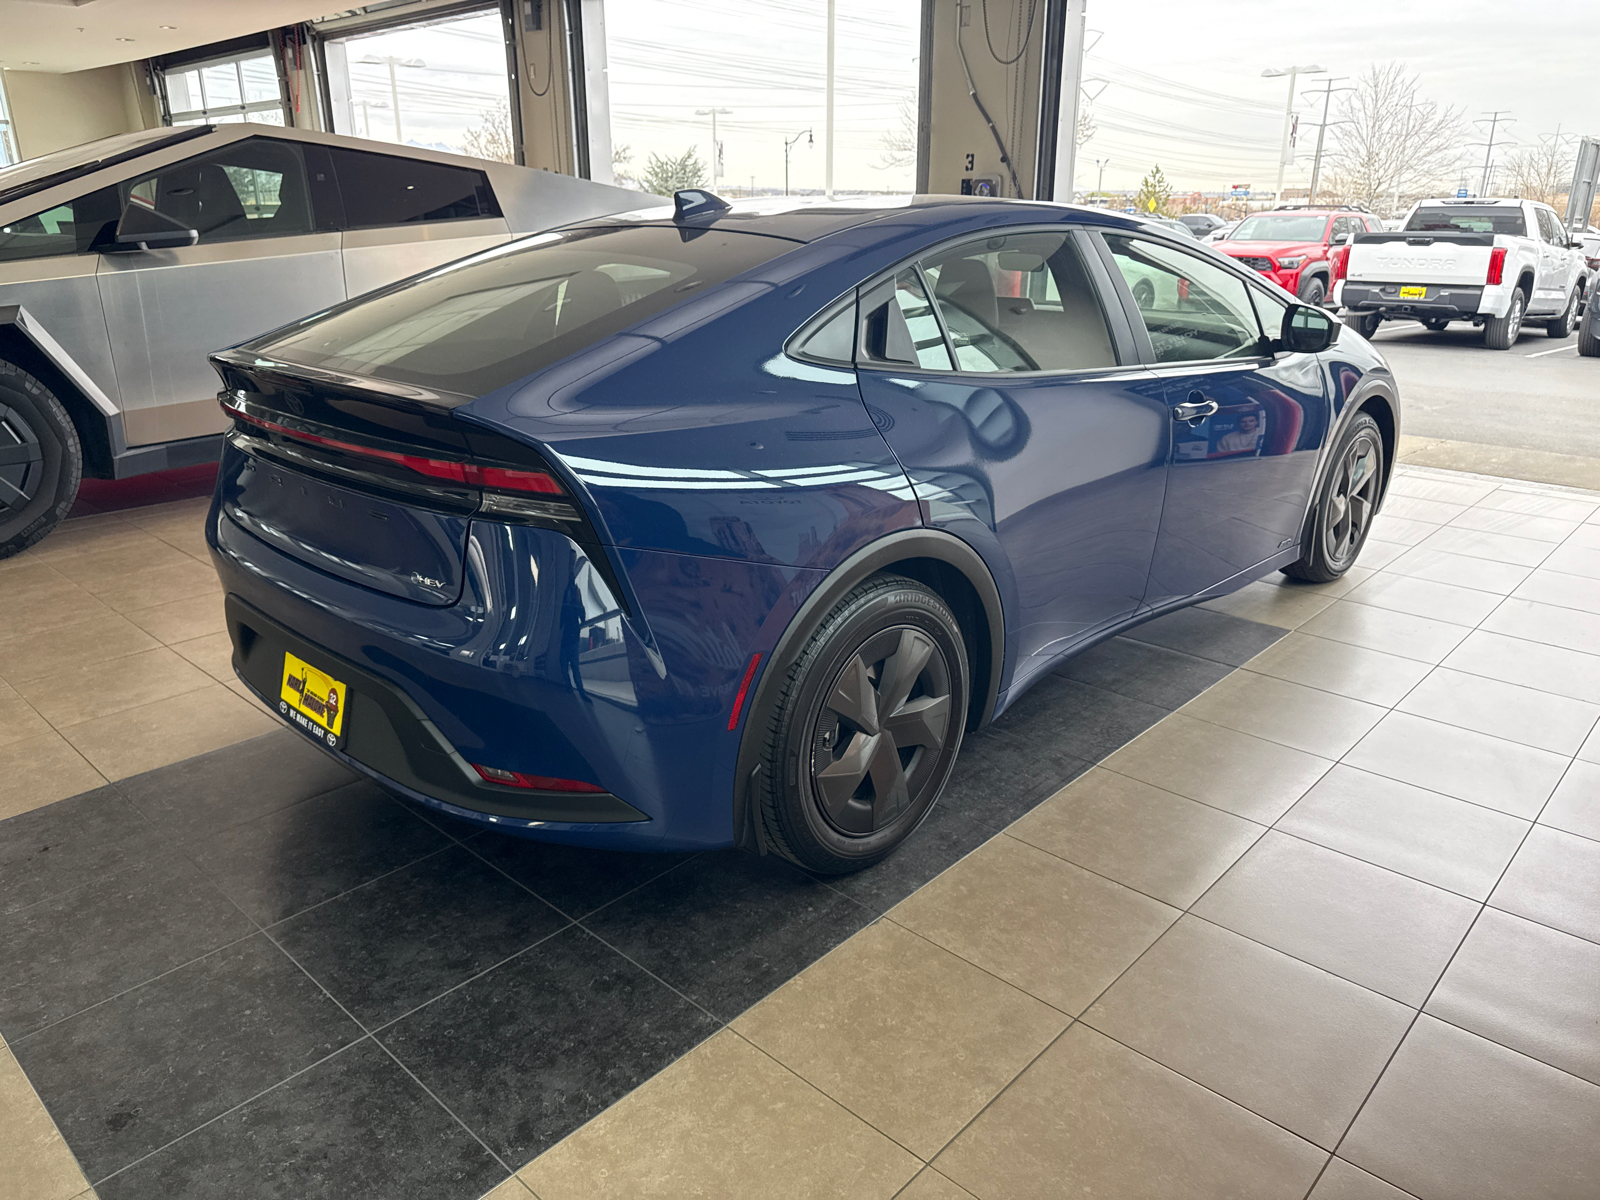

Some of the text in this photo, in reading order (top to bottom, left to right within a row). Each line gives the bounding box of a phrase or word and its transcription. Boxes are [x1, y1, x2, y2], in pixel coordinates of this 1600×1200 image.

[965, 153, 975, 171] 3
[1377, 257, 1456, 269] TUNDRA
[290, 708, 296, 720] WE
[296, 714, 308, 728] MAKE
[313, 724, 324, 738] EASY
